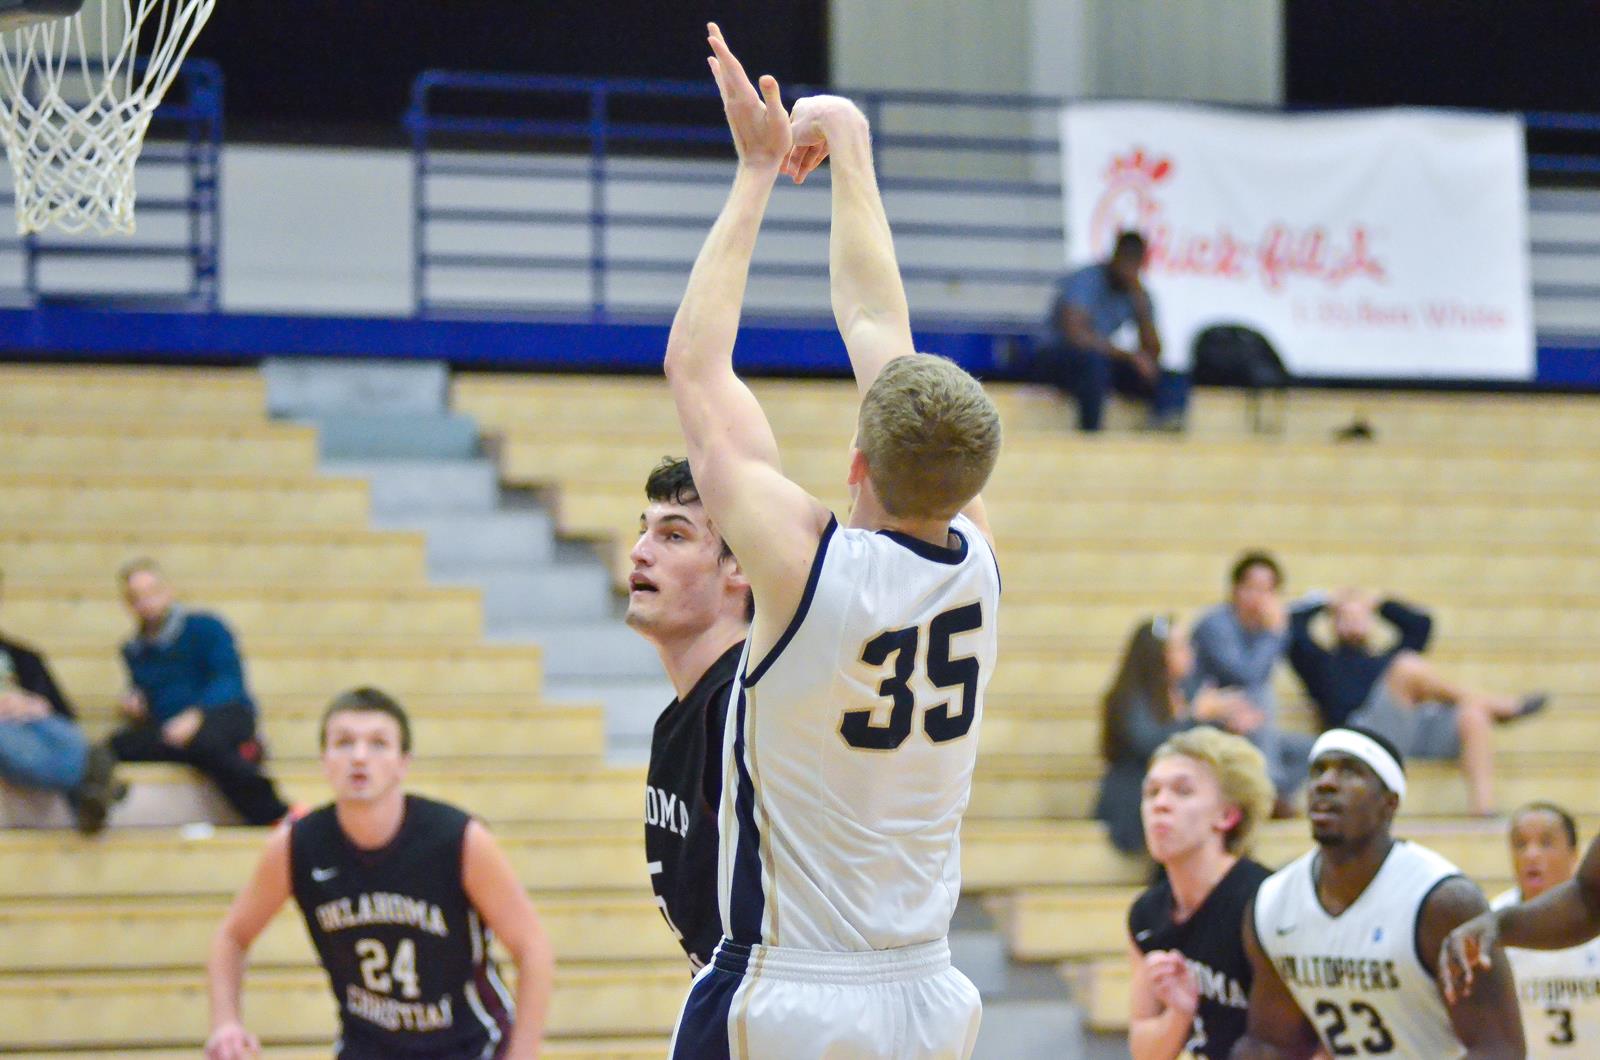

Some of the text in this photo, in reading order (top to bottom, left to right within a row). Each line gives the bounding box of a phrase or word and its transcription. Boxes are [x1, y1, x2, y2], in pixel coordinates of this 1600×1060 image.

[837, 598, 984, 752] 35
[645, 785, 690, 838] OMA
[316, 891, 448, 938] OKLAHOMA
[355, 938, 421, 999] 24
[1315, 999, 1396, 1056] 23
[1546, 1009, 1575, 1045] 3
